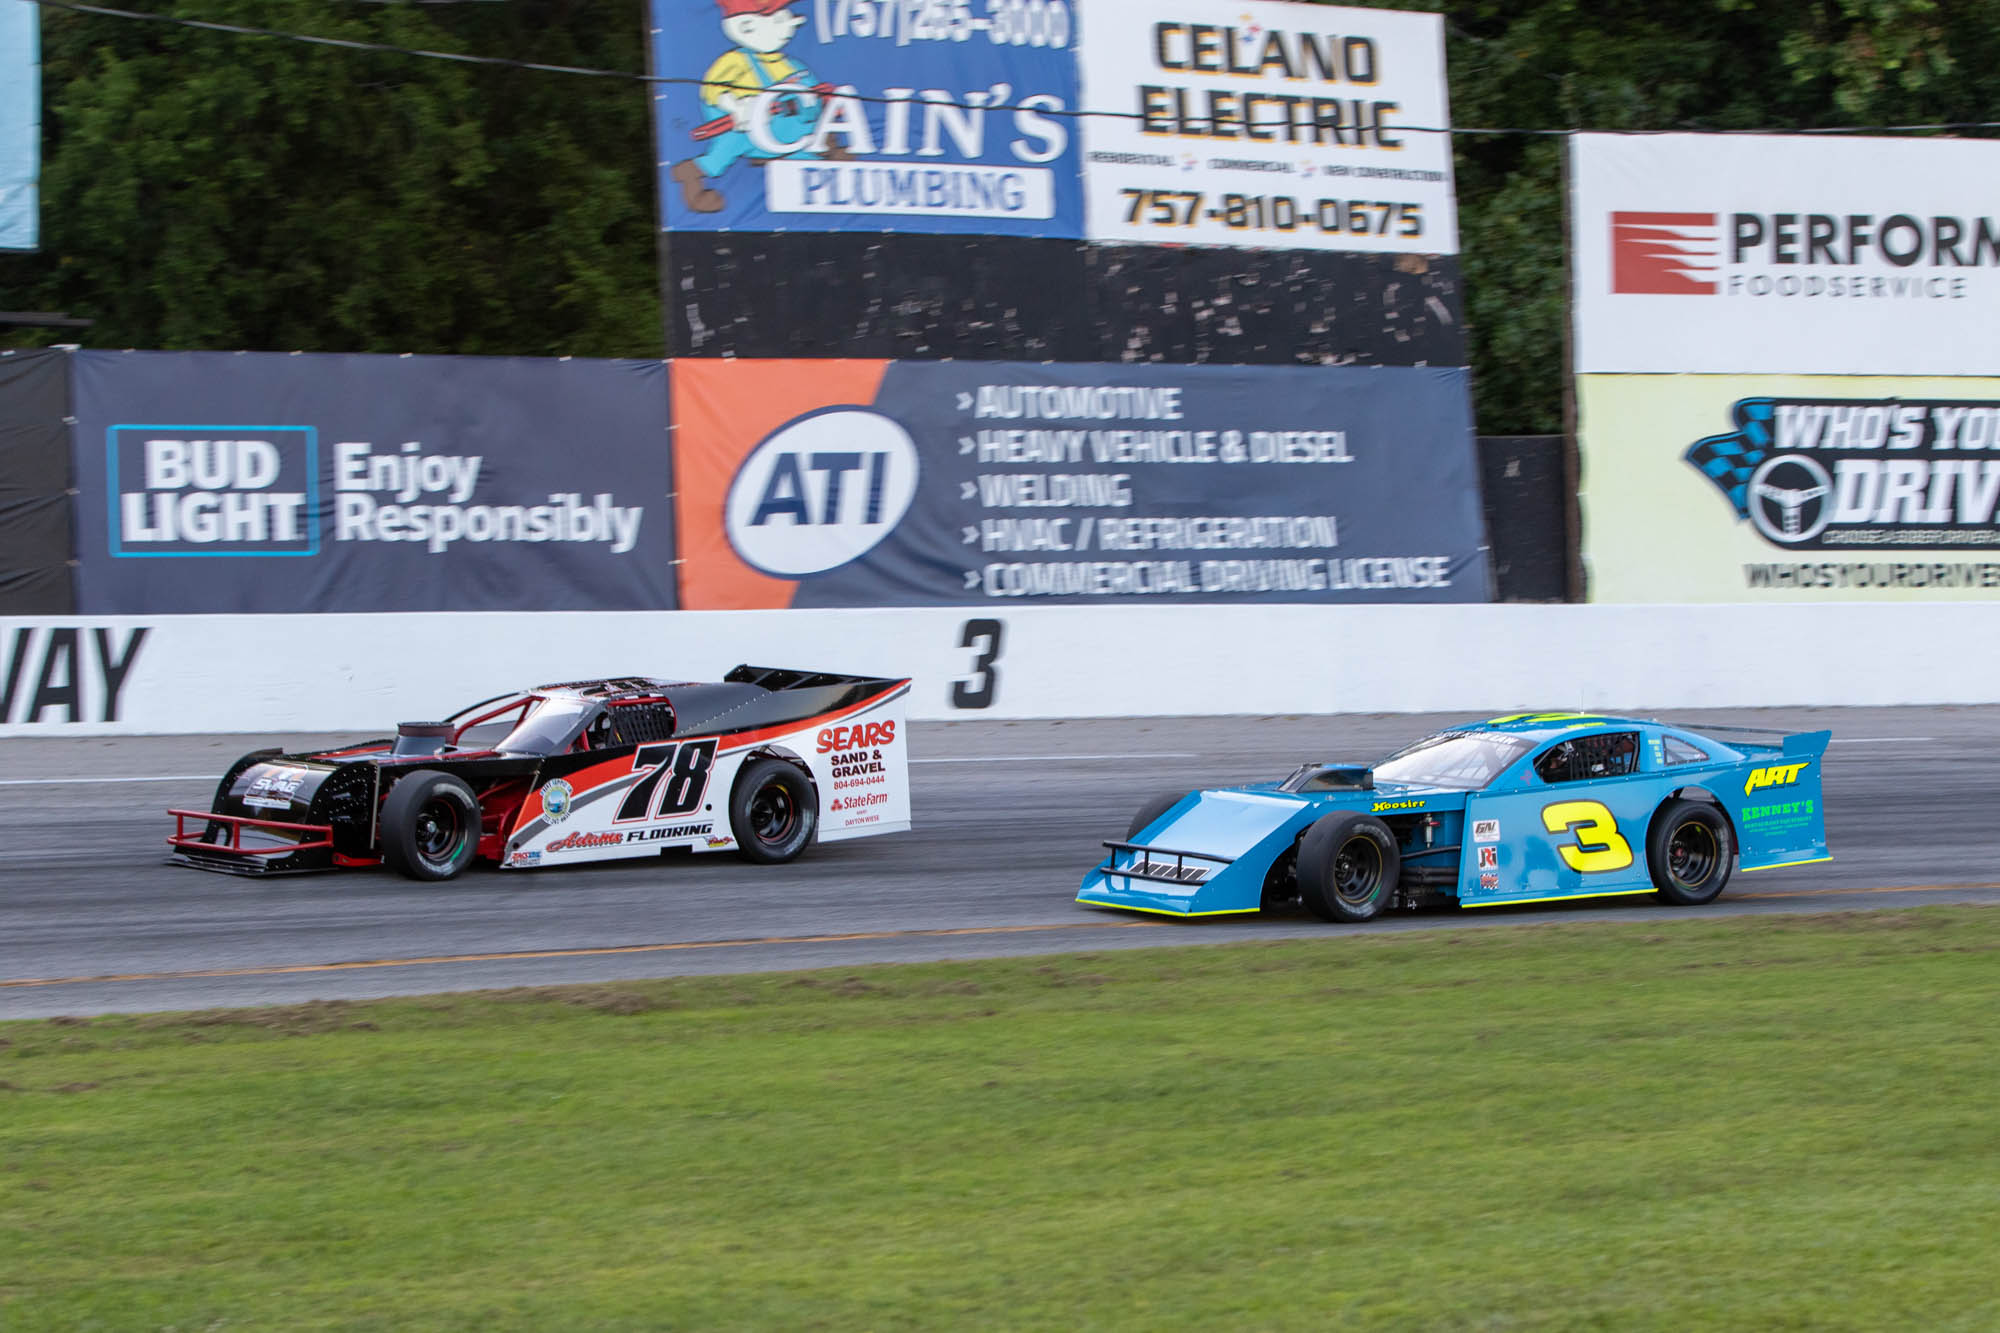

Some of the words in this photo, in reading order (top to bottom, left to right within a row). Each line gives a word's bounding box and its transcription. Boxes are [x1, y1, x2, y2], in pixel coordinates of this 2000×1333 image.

[1154, 22, 1380, 85] CELANO
[749, 83, 1068, 163] CAIN'S
[1137, 85, 1404, 151] ELECTRIC
[801, 168, 1027, 212] PLUMBING
[1119, 188, 1424, 238] 757-810-0675
[1727, 275, 1968, 298] FOODSERVICE
[975, 385, 1184, 419] AUTOMOTIVE
[977, 430, 1088, 463] HEAVY
[1088, 430, 1218, 463] VEHICLE
[1219, 430, 1249, 463] &
[1249, 431, 1356, 463] DIESEL
[1773, 404, 1928, 449] WHO'S
[144, 440, 281, 489] BUD
[333, 442, 484, 503] Enjoy
[745, 451, 893, 526] ATI
[977, 474, 1133, 507] WELDING
[1828, 459, 2000, 523] DRIV
[120, 492, 306, 542] LIGHT
[333, 493, 645, 554] Responsibly
[981, 518, 1073, 552] HVAC
[1097, 516, 1338, 550] REFRIGERATION
[982, 561, 1200, 596] COMMERCIAL
[1200, 559, 1328, 592] DRIVING
[1328, 556, 1453, 589] LICENSE
[948, 618, 1005, 710] 3
[816, 720, 895, 754] SEARS
[831, 752, 868, 766] SAND
[872, 749, 882, 760] &
[613, 737, 720, 824] 78
[832, 761, 886, 778] GRAVEL
[834, 775, 885, 789] 804-694-0444
[1744, 761, 1812, 798] ART
[1741, 800, 1814, 822] KENNEY'S
[545, 832, 623, 852] Adams
[626, 824, 713, 841] FLOORING
[1541, 800, 1634, 873] 3
